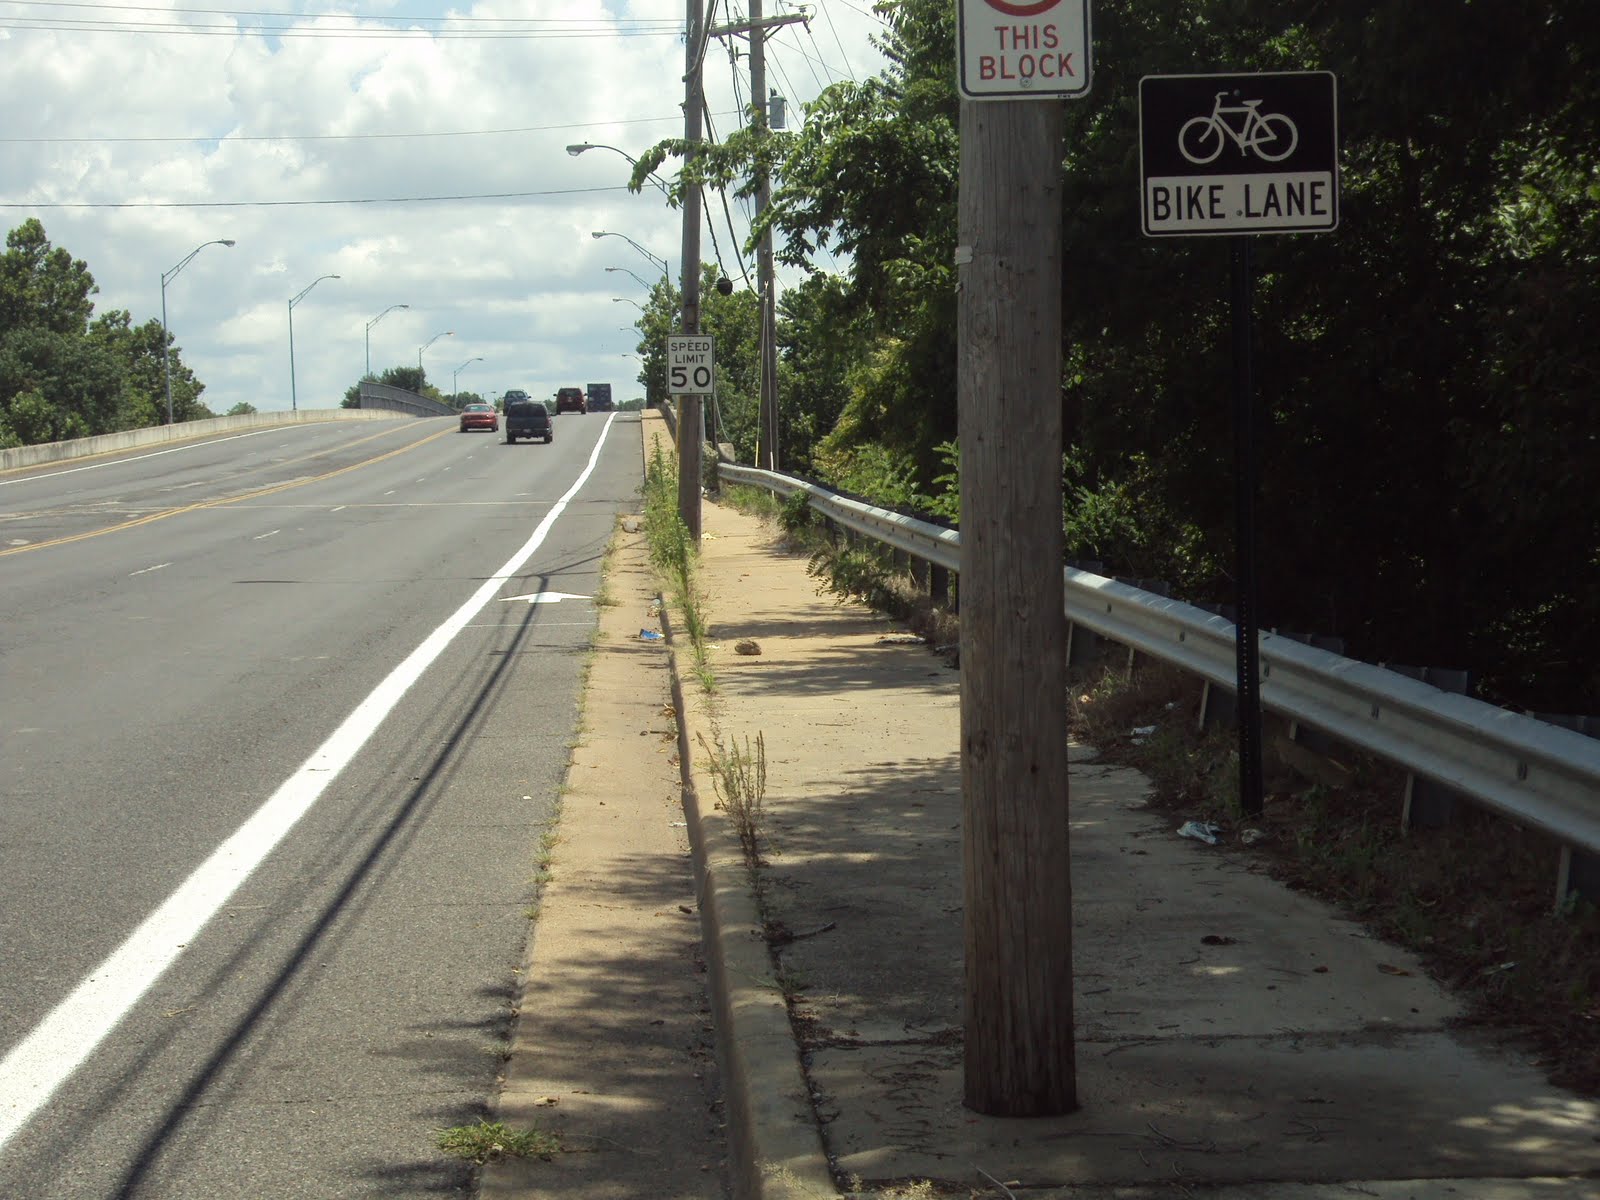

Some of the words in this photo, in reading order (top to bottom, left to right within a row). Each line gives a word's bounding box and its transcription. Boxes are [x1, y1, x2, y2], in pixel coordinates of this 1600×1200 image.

[994, 24, 1059, 50] THIS
[980, 53, 1075, 80] BLOCK
[1152, 185, 1226, 221] BIKE
[1244, 181, 1327, 218] LANE
[671, 342, 710, 352] SPEED
[675, 354, 705, 364] LIMIT
[671, 366, 711, 388] 50
